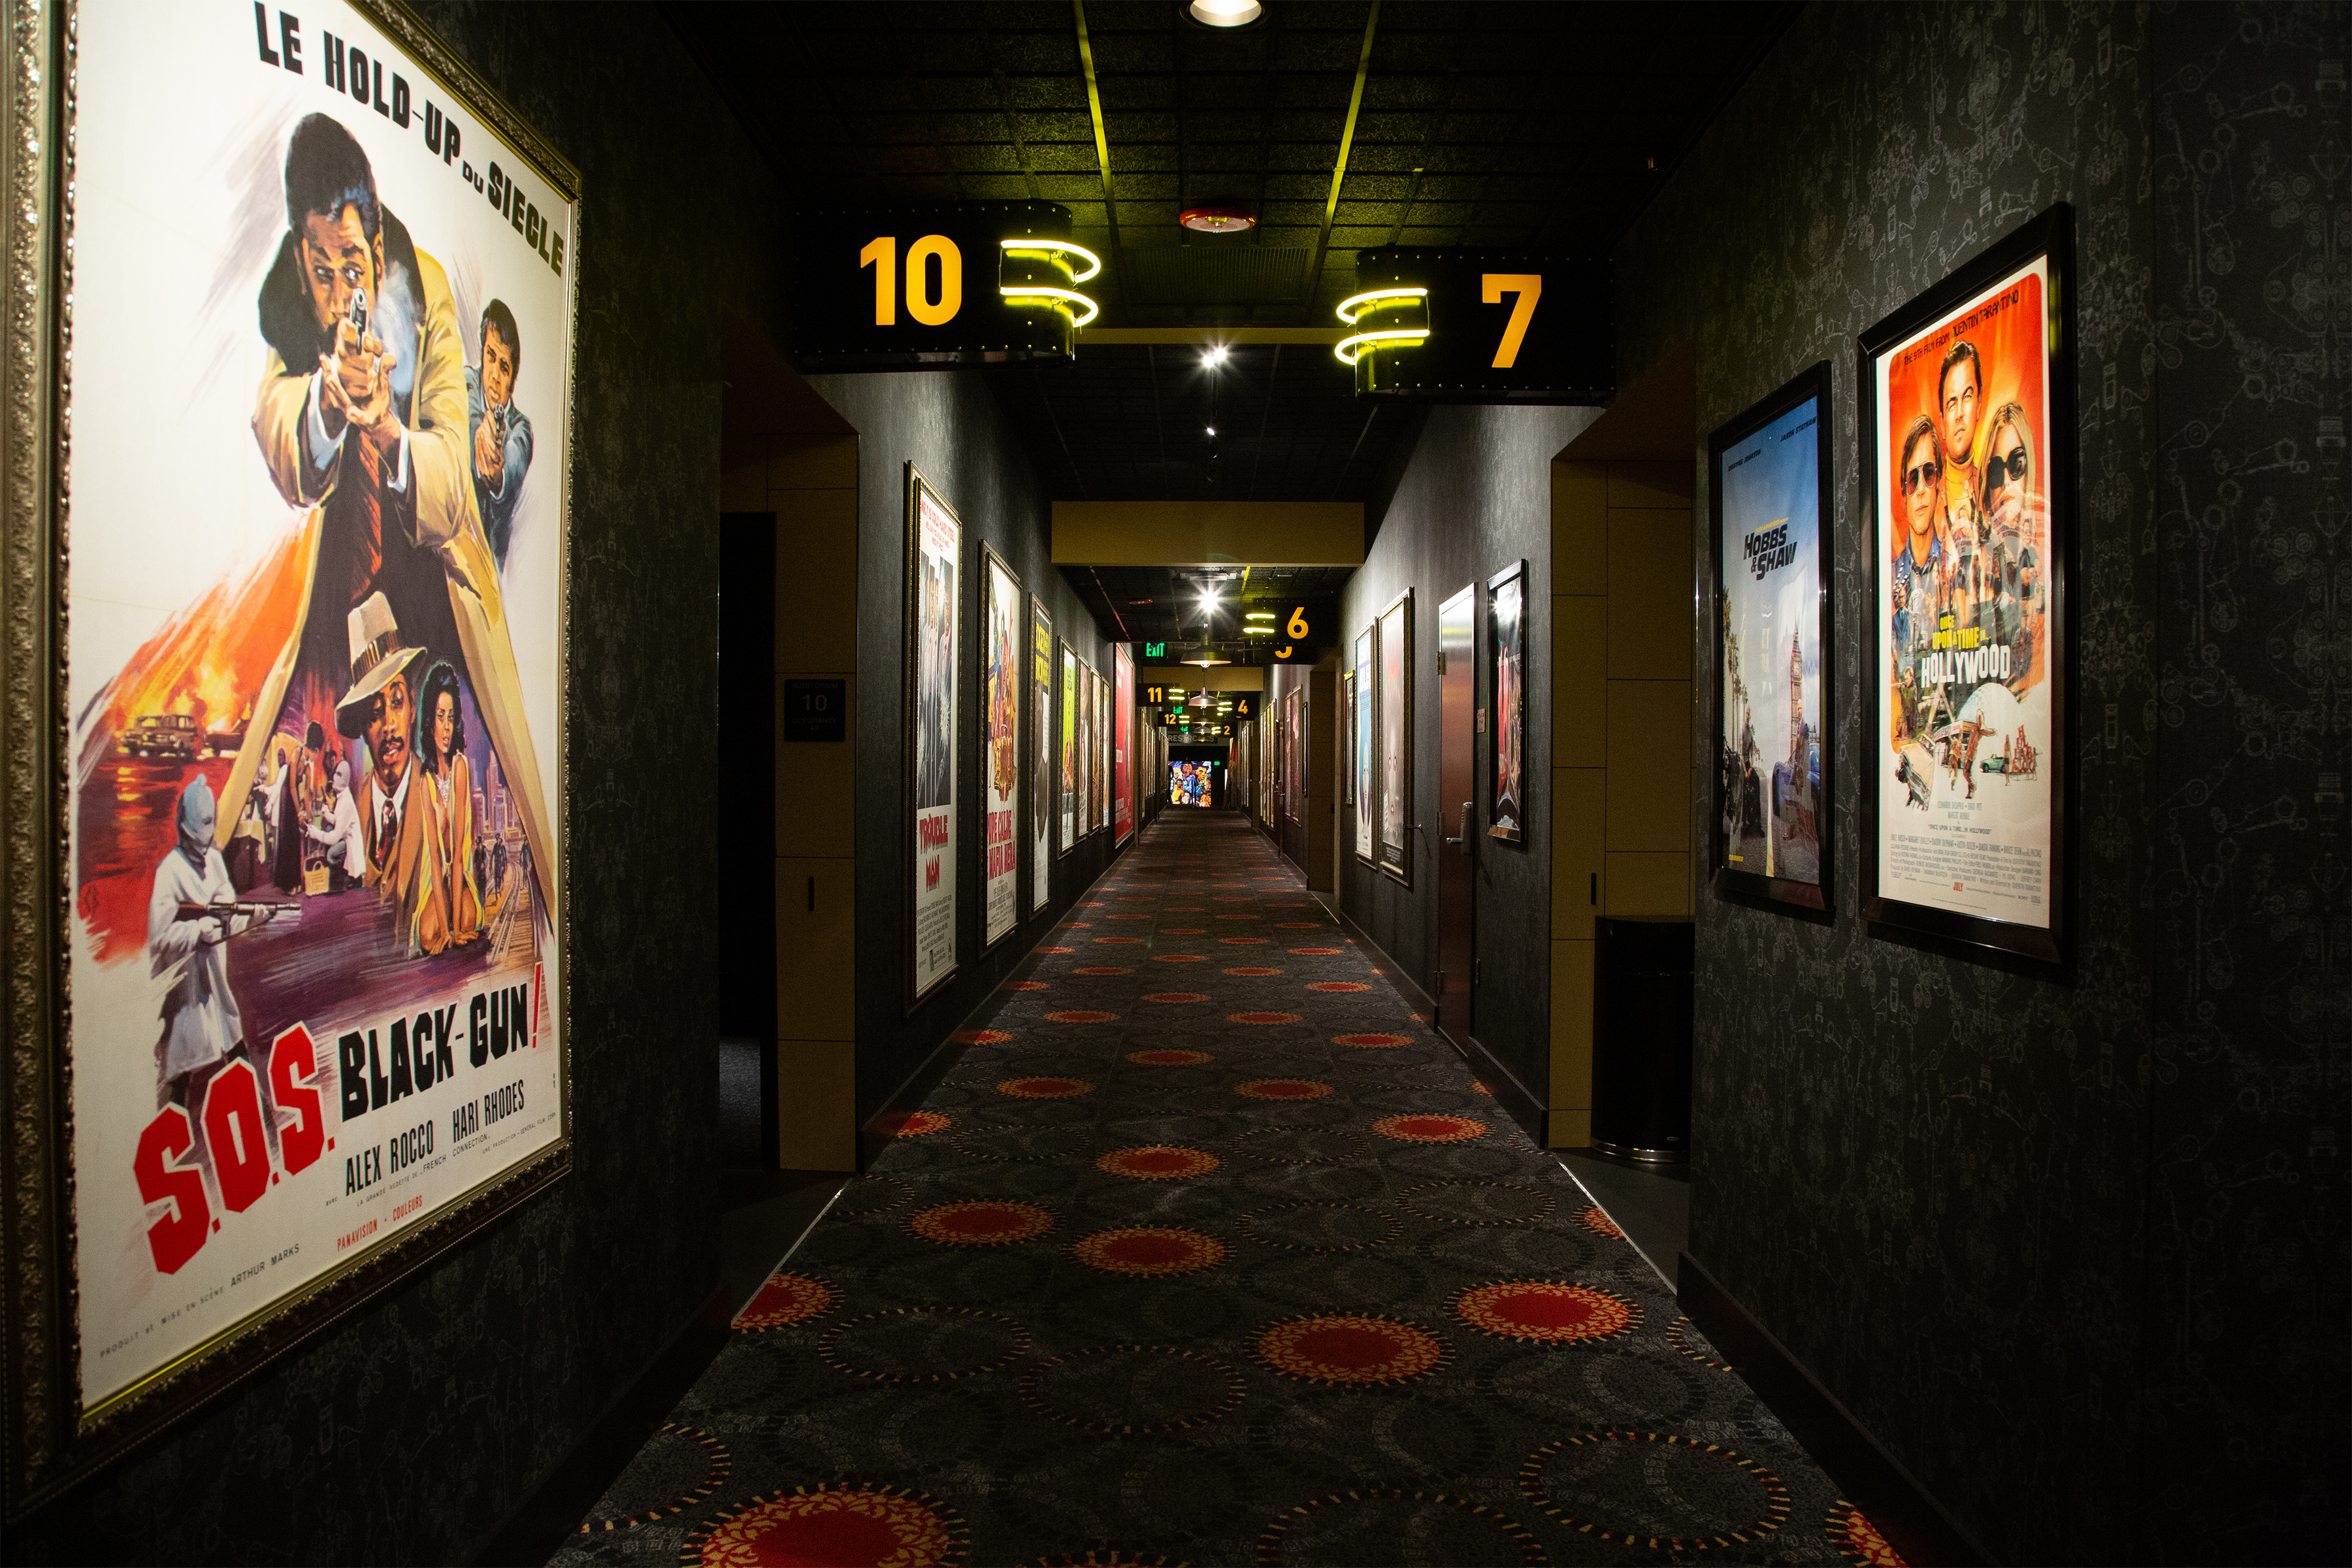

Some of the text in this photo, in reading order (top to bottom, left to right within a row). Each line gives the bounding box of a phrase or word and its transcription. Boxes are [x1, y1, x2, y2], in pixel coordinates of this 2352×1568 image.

[253, 0, 303, 75] LE
[323, 30, 461, 167] HOLD-UP
[462, 159, 484, 195] DU
[860, 234, 962, 326] 10
[1481, 273, 1542, 368] 7
[1936, 332, 1950, 348] FROM
[1952, 312, 1978, 338] QUENTIN
[1979, 289, 2019, 322] TARANTINO
[1743, 523, 1788, 561] HOBBS
[1750, 541, 1798, 581] & SHAW
[1287, 606, 1309, 640] 6
[1932, 629, 1953, 650] UPON
[1957, 627, 1980, 650] TIME
[1940, 615, 1955, 630] ONCE
[1146, 642, 1165, 657] EXIT
[1921, 644, 2011, 689] HOLLYWOOD
[802, 694, 828, 711] 10
[1147, 687, 1162, 702] 11
[1237, 699, 1249, 714] 4
[1164, 713, 1177, 725] 12
[1224, 725, 1230, 735] 2
[919, 813, 949, 853] TROUBLE
[926, 855, 940, 891] MAN
[1953, 881, 1964, 892] JULY
[345, 1145, 382, 1197] ALEX
[390, 1119, 434, 1175] ROCCO
[452, 1099, 479, 1143] HARI
[484, 1079, 524, 1127] RHODES
[336, 1194, 423, 1252] PANAVISION COULEURS
[230, 1261, 266, 1288] ARTHUR
[270, 1243, 301, 1266] MARKS
